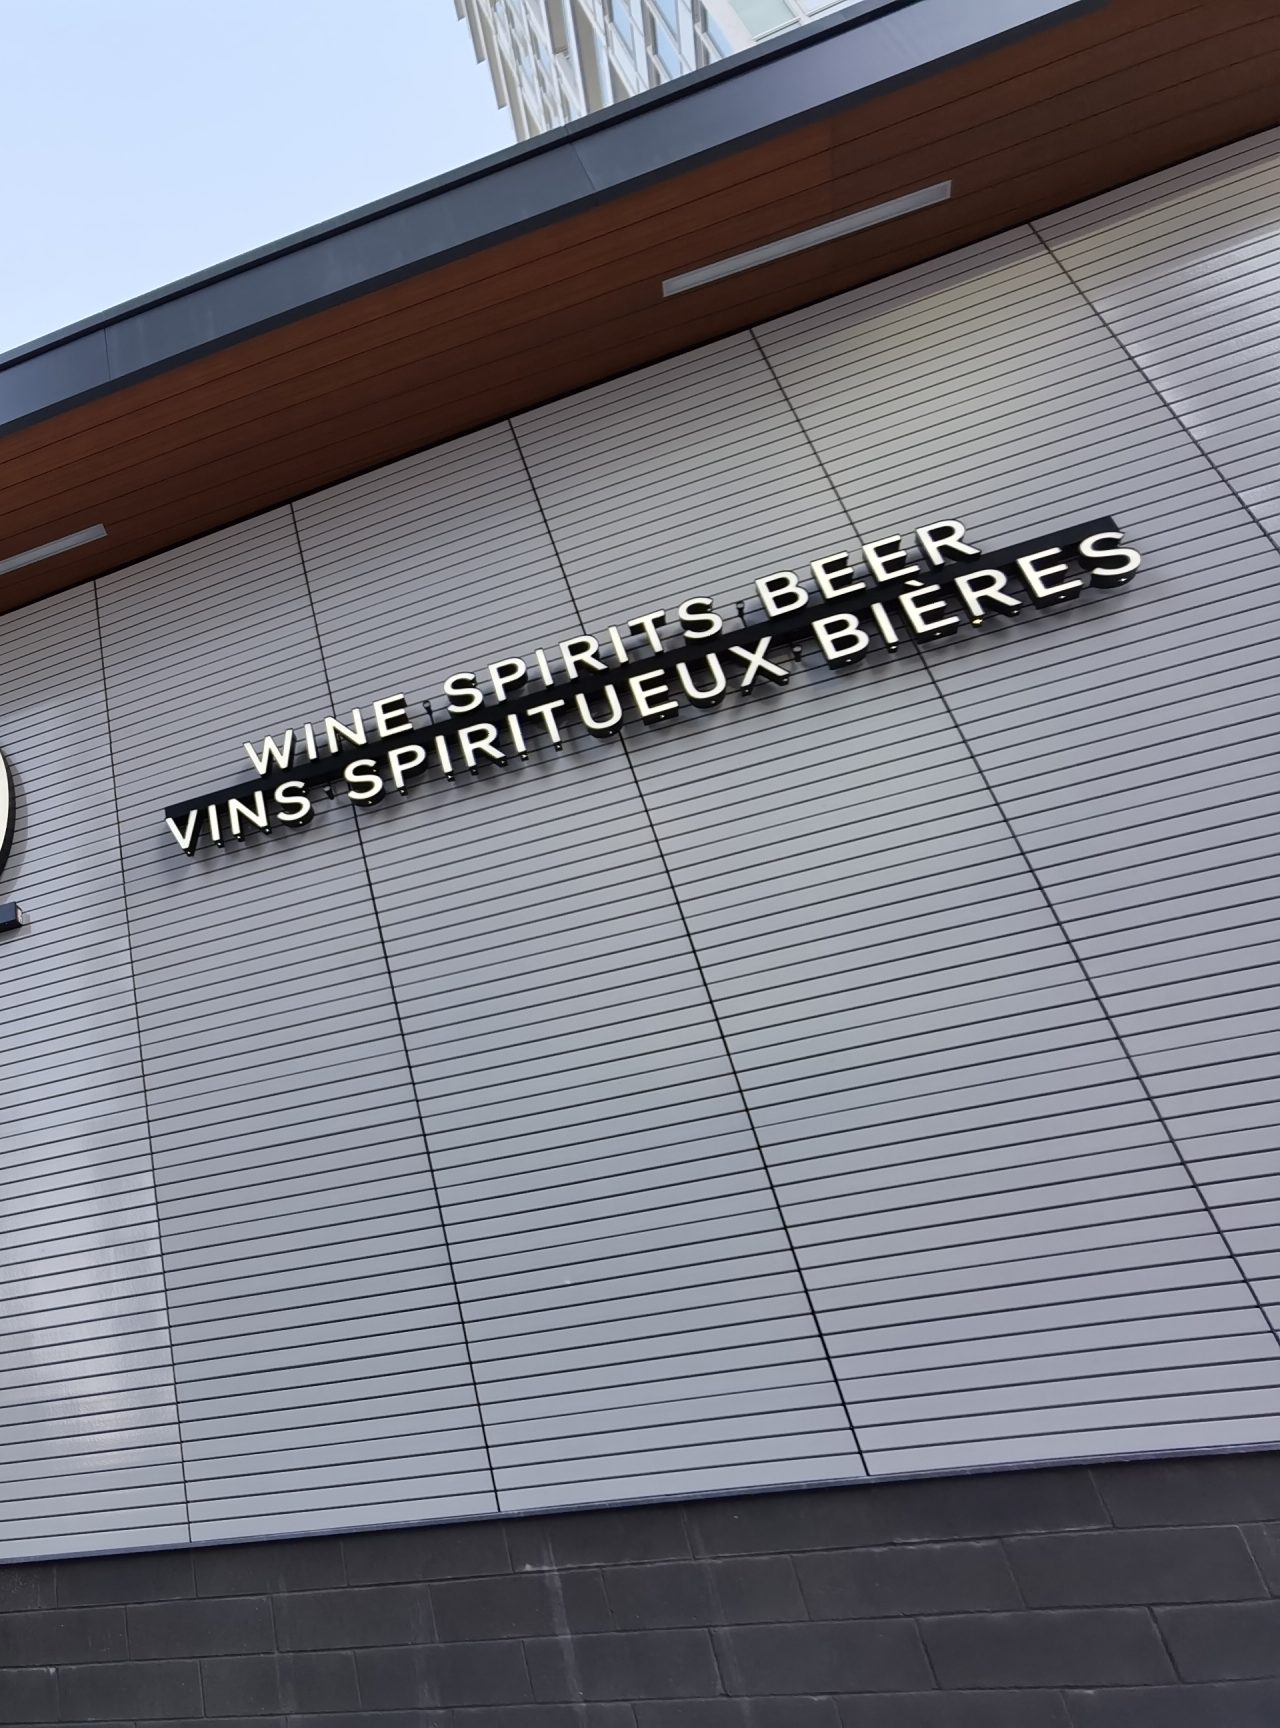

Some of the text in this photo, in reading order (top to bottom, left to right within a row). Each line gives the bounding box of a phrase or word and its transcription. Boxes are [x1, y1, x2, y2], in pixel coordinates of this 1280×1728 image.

[166, 531, 1142, 852] VINS SPIRITUEUX BIÈRES
[243, 519, 981, 777] WINE SPIRITS BEER
